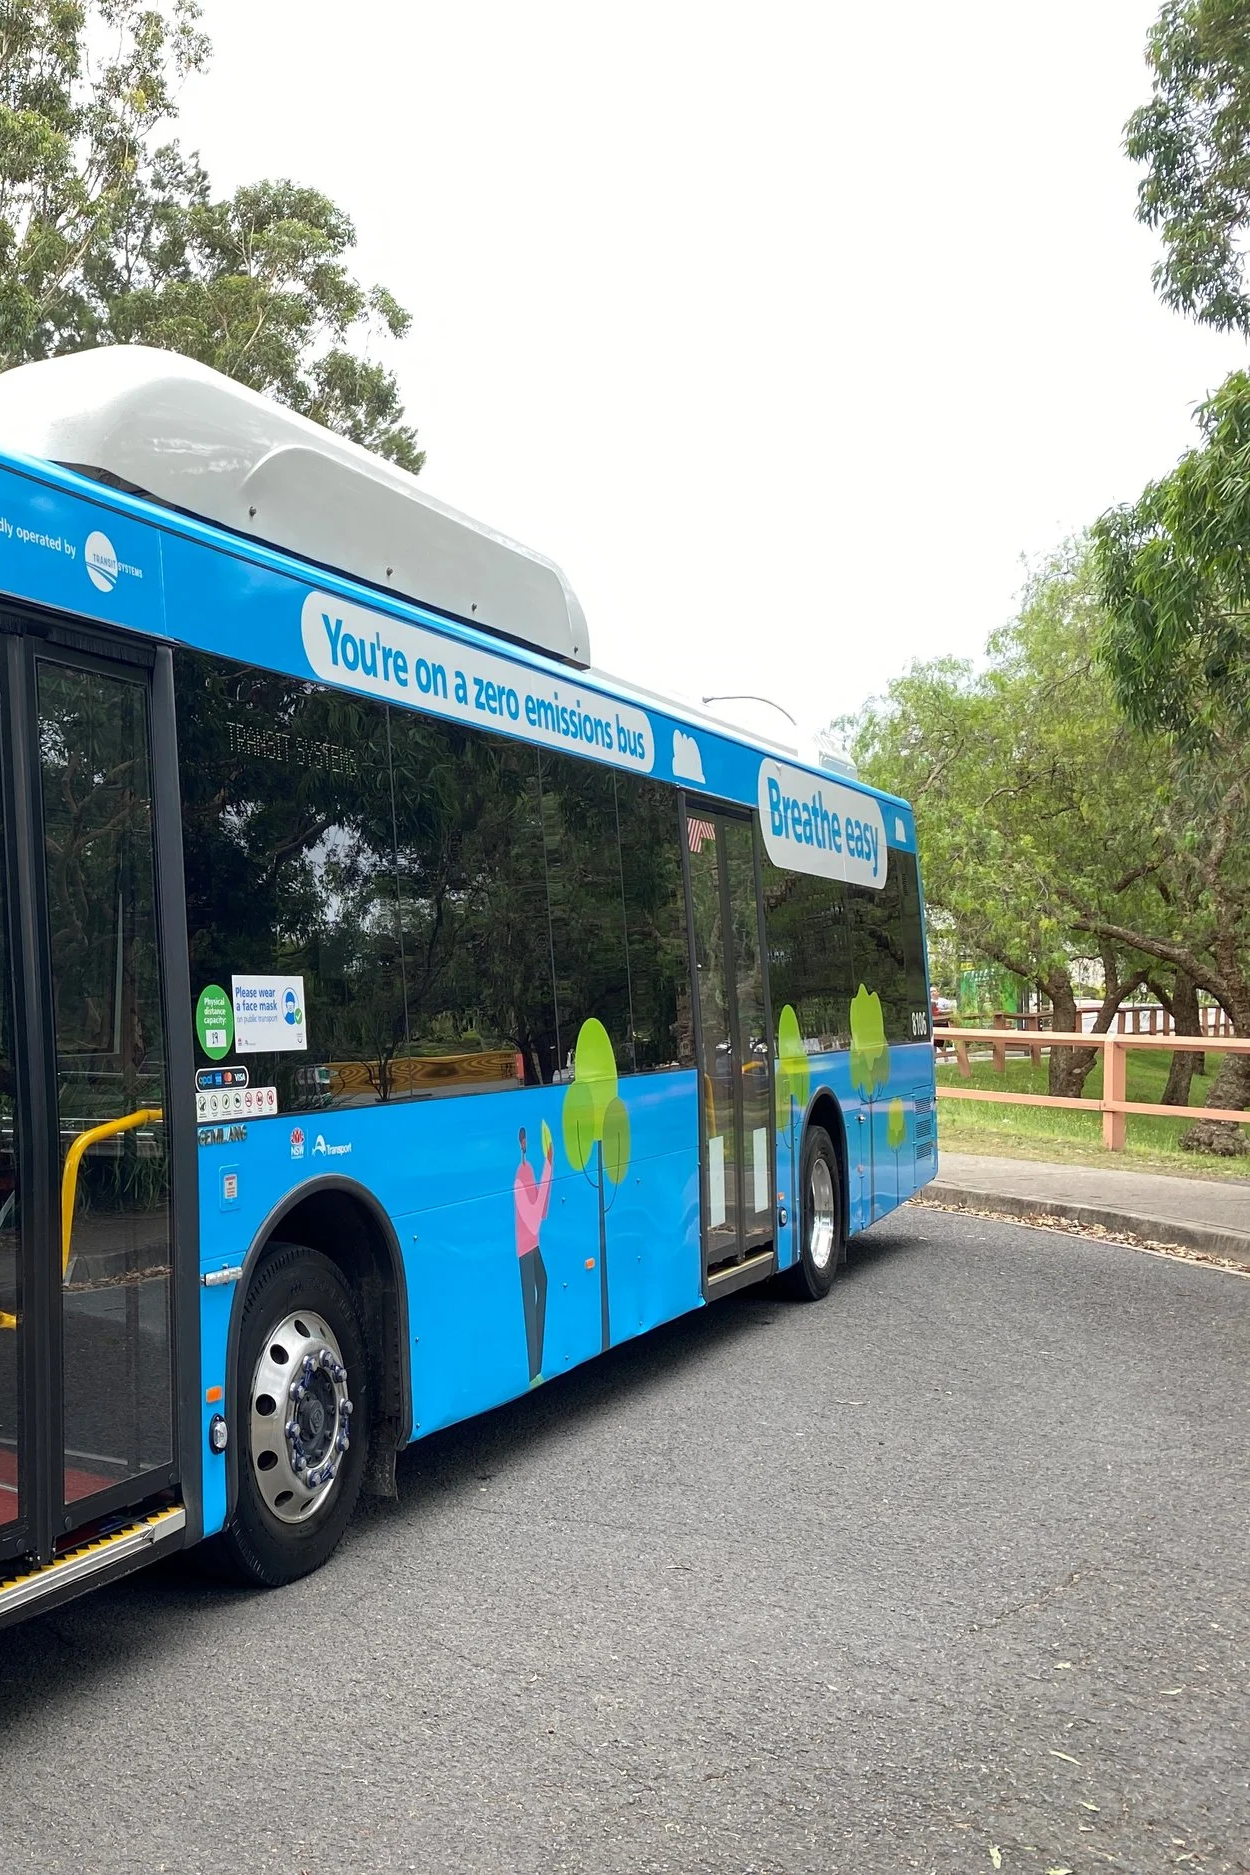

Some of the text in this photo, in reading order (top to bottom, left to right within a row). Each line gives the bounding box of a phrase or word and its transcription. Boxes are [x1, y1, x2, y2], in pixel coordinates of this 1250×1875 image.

[16, 526, 62, 552] operated
[64, 539, 77, 560] by
[92, 552, 143, 579] TRANSIT SYSTEMS
[321, 613, 646, 760] You're on a zero emissions bus
[226, 721, 290, 762] TRANSIT
[767, 776, 879, 878] Breathe easy
[235, 986, 276, 998] Please wear
[203, 997, 225, 1007] Physical
[236, 999, 278, 1011] a face mask
[203, 1007, 226, 1016] distance
[912, 1011, 927, 1036] 8106
[234, 1072, 246, 1082] VISA
[290, 1144, 304, 1156] NSW
[326, 1142, 352, 1156] Transport
